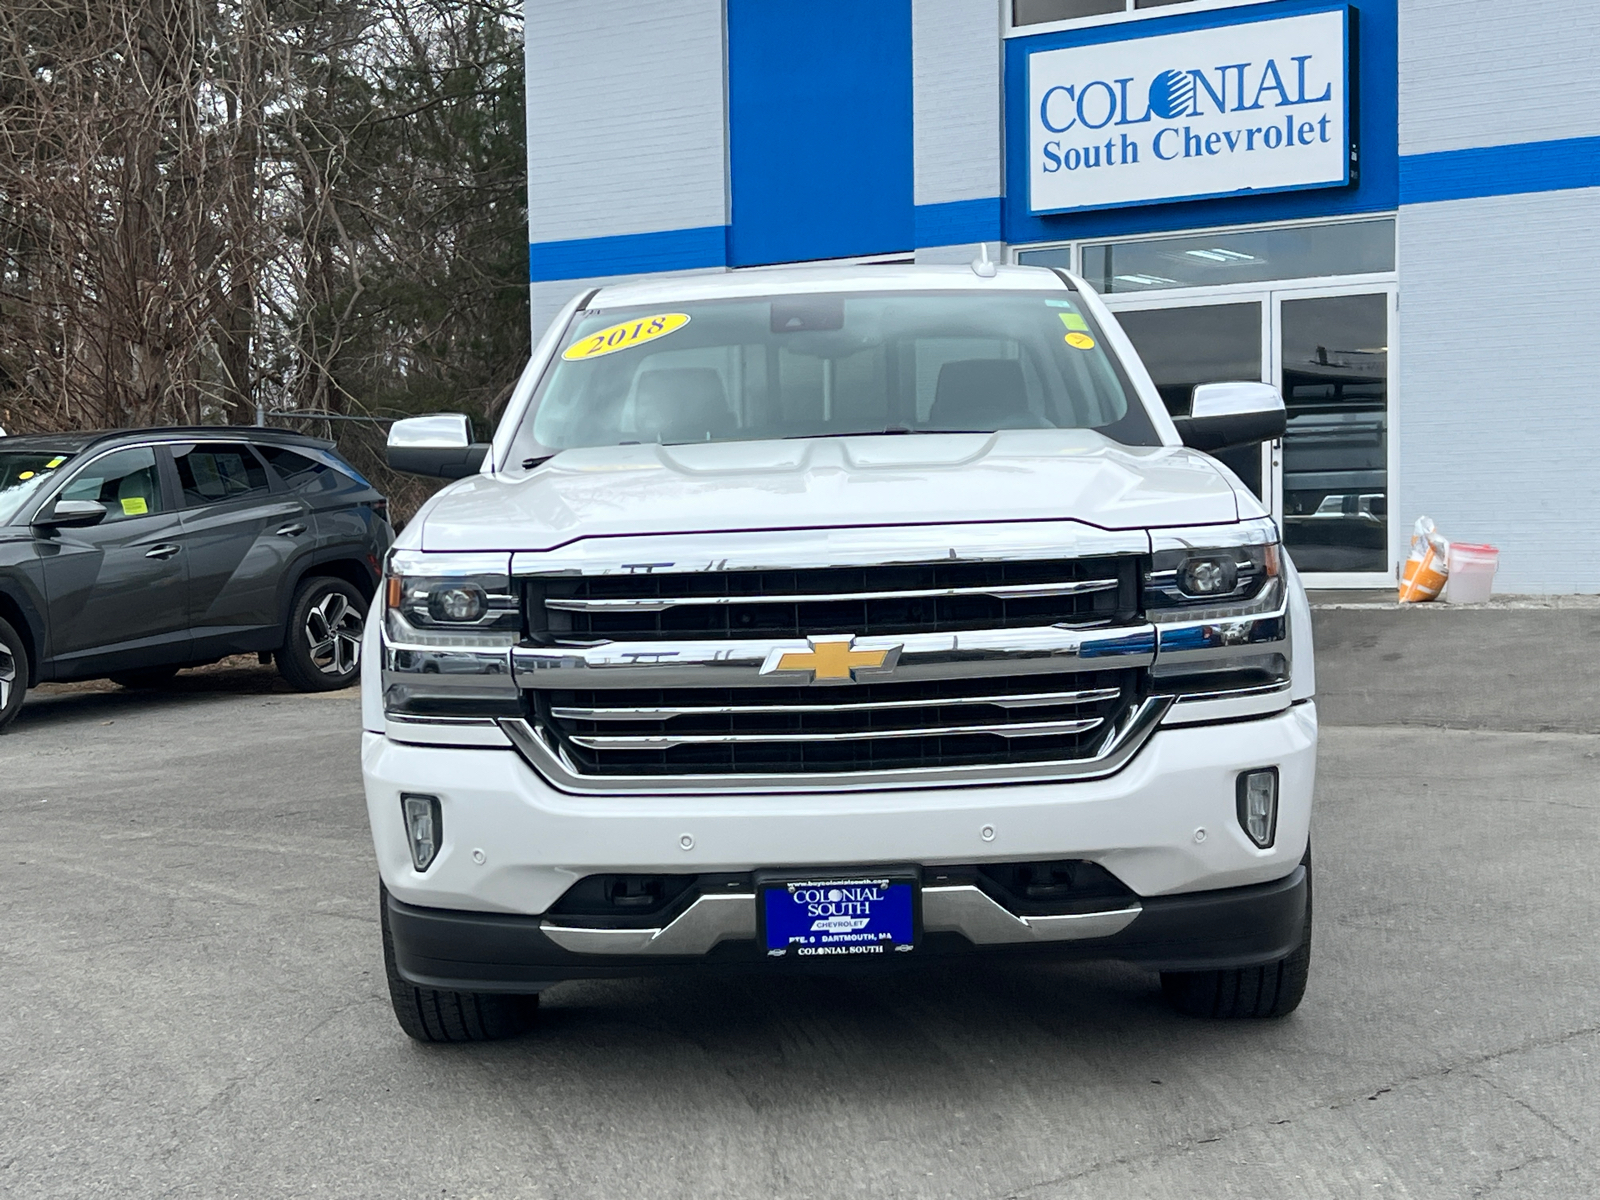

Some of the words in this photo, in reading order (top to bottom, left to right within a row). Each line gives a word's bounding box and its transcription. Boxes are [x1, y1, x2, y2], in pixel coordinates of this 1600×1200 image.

[1040, 55, 1332, 134] COLONIAL
[1042, 133, 1140, 174] South
[1152, 113, 1332, 162] Chevrolet
[586, 316, 667, 355] 2018
[793, 887, 885, 904] COLONIAL
[807, 902, 871, 917] SOUTH
[816, 920, 864, 929] CHEVROLET
[797, 946, 849, 956] COLONIAL
[849, 945, 884, 954] SOUTH
